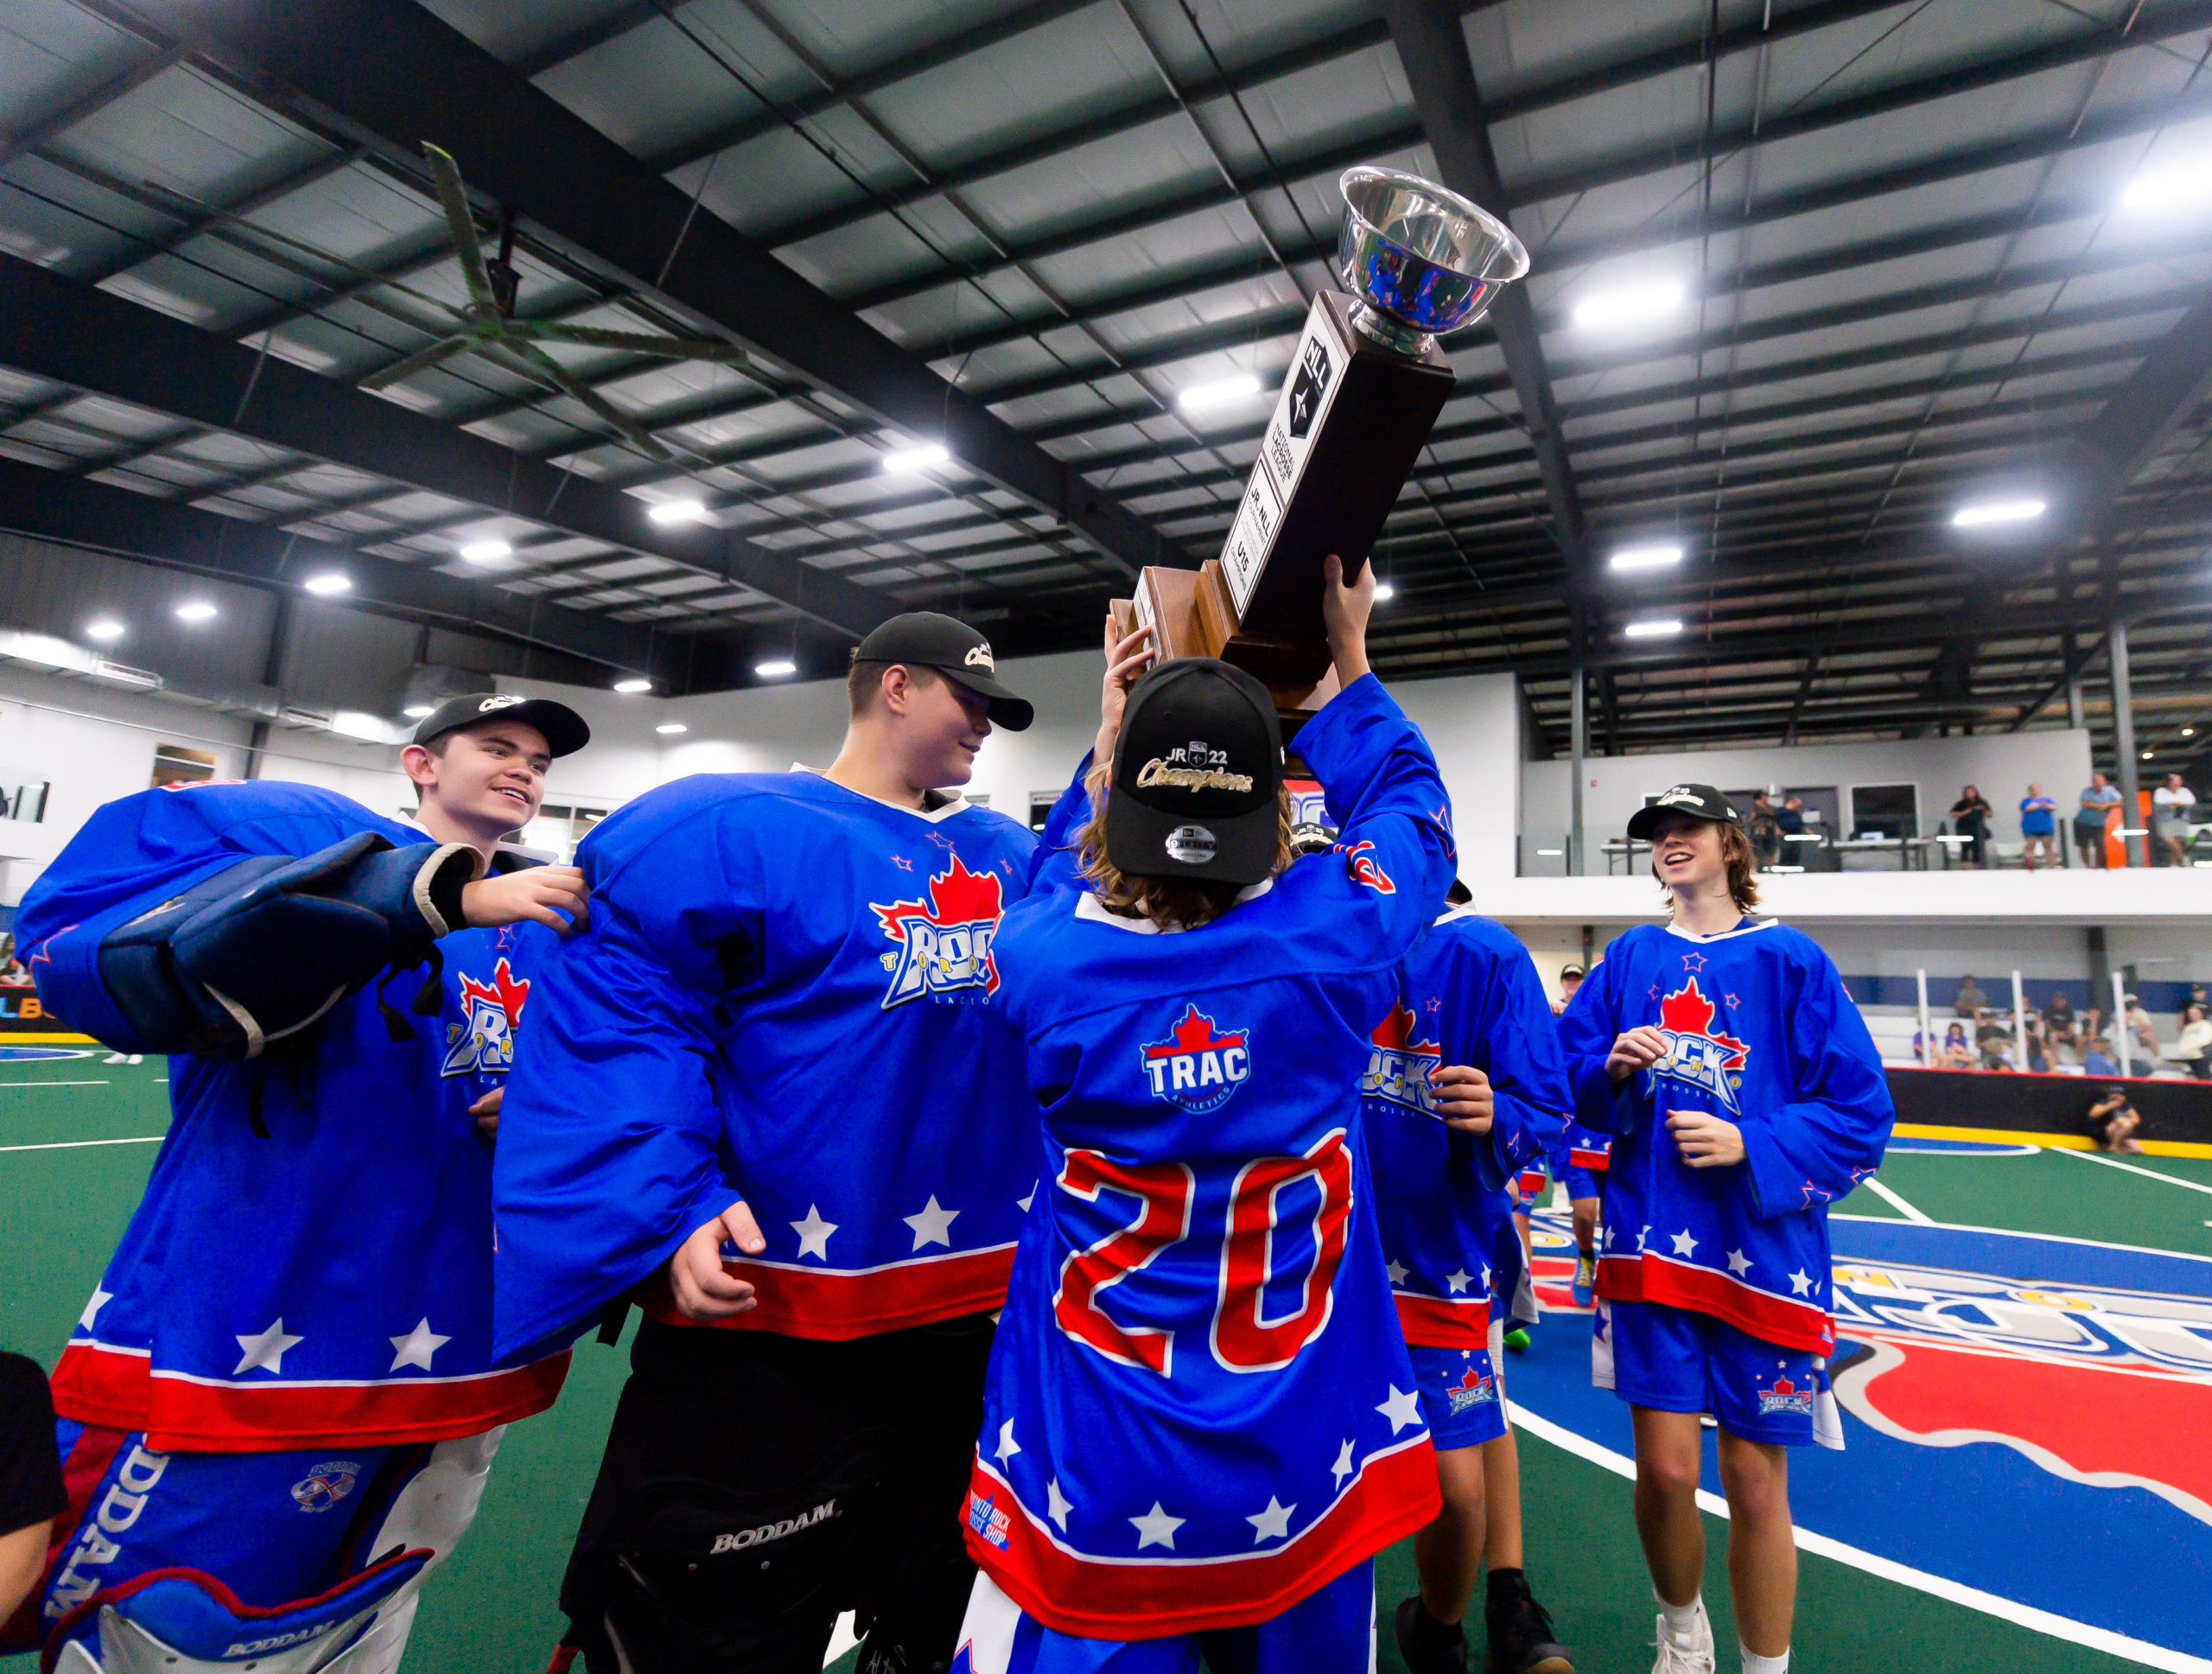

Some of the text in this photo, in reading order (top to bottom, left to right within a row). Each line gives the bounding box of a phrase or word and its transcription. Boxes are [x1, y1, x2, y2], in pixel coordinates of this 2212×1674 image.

[1306, 340, 1327, 390] NLL
[1271, 444, 1287, 484] LEAGUE
[1272, 431, 1294, 481] LACROSSE
[1275, 422, 1295, 471] NATIONAL
[1251, 487, 1271, 538] JR. NLL
[1231, 546, 1247, 591] CHAMPIONS
[1237, 540, 1249, 572] U15
[1136, 757, 1253, 793] Champions
[1166, 748, 1187, 762] JR
[1209, 750, 1228, 765] 22
[1146, 1047, 1248, 1093] TRAC
[1172, 1085, 1230, 1110] ATHLETICS
[1052, 1127, 1353, 1378] 20
[45, 1432, 171, 1618] DDAM
[710, 1498, 836, 1555] BODDAM
[982, 1522, 1007, 1548] SHOP
[988, 1507, 1011, 1533] ROCK
[222, 1620, 335, 1658] BODDAM
